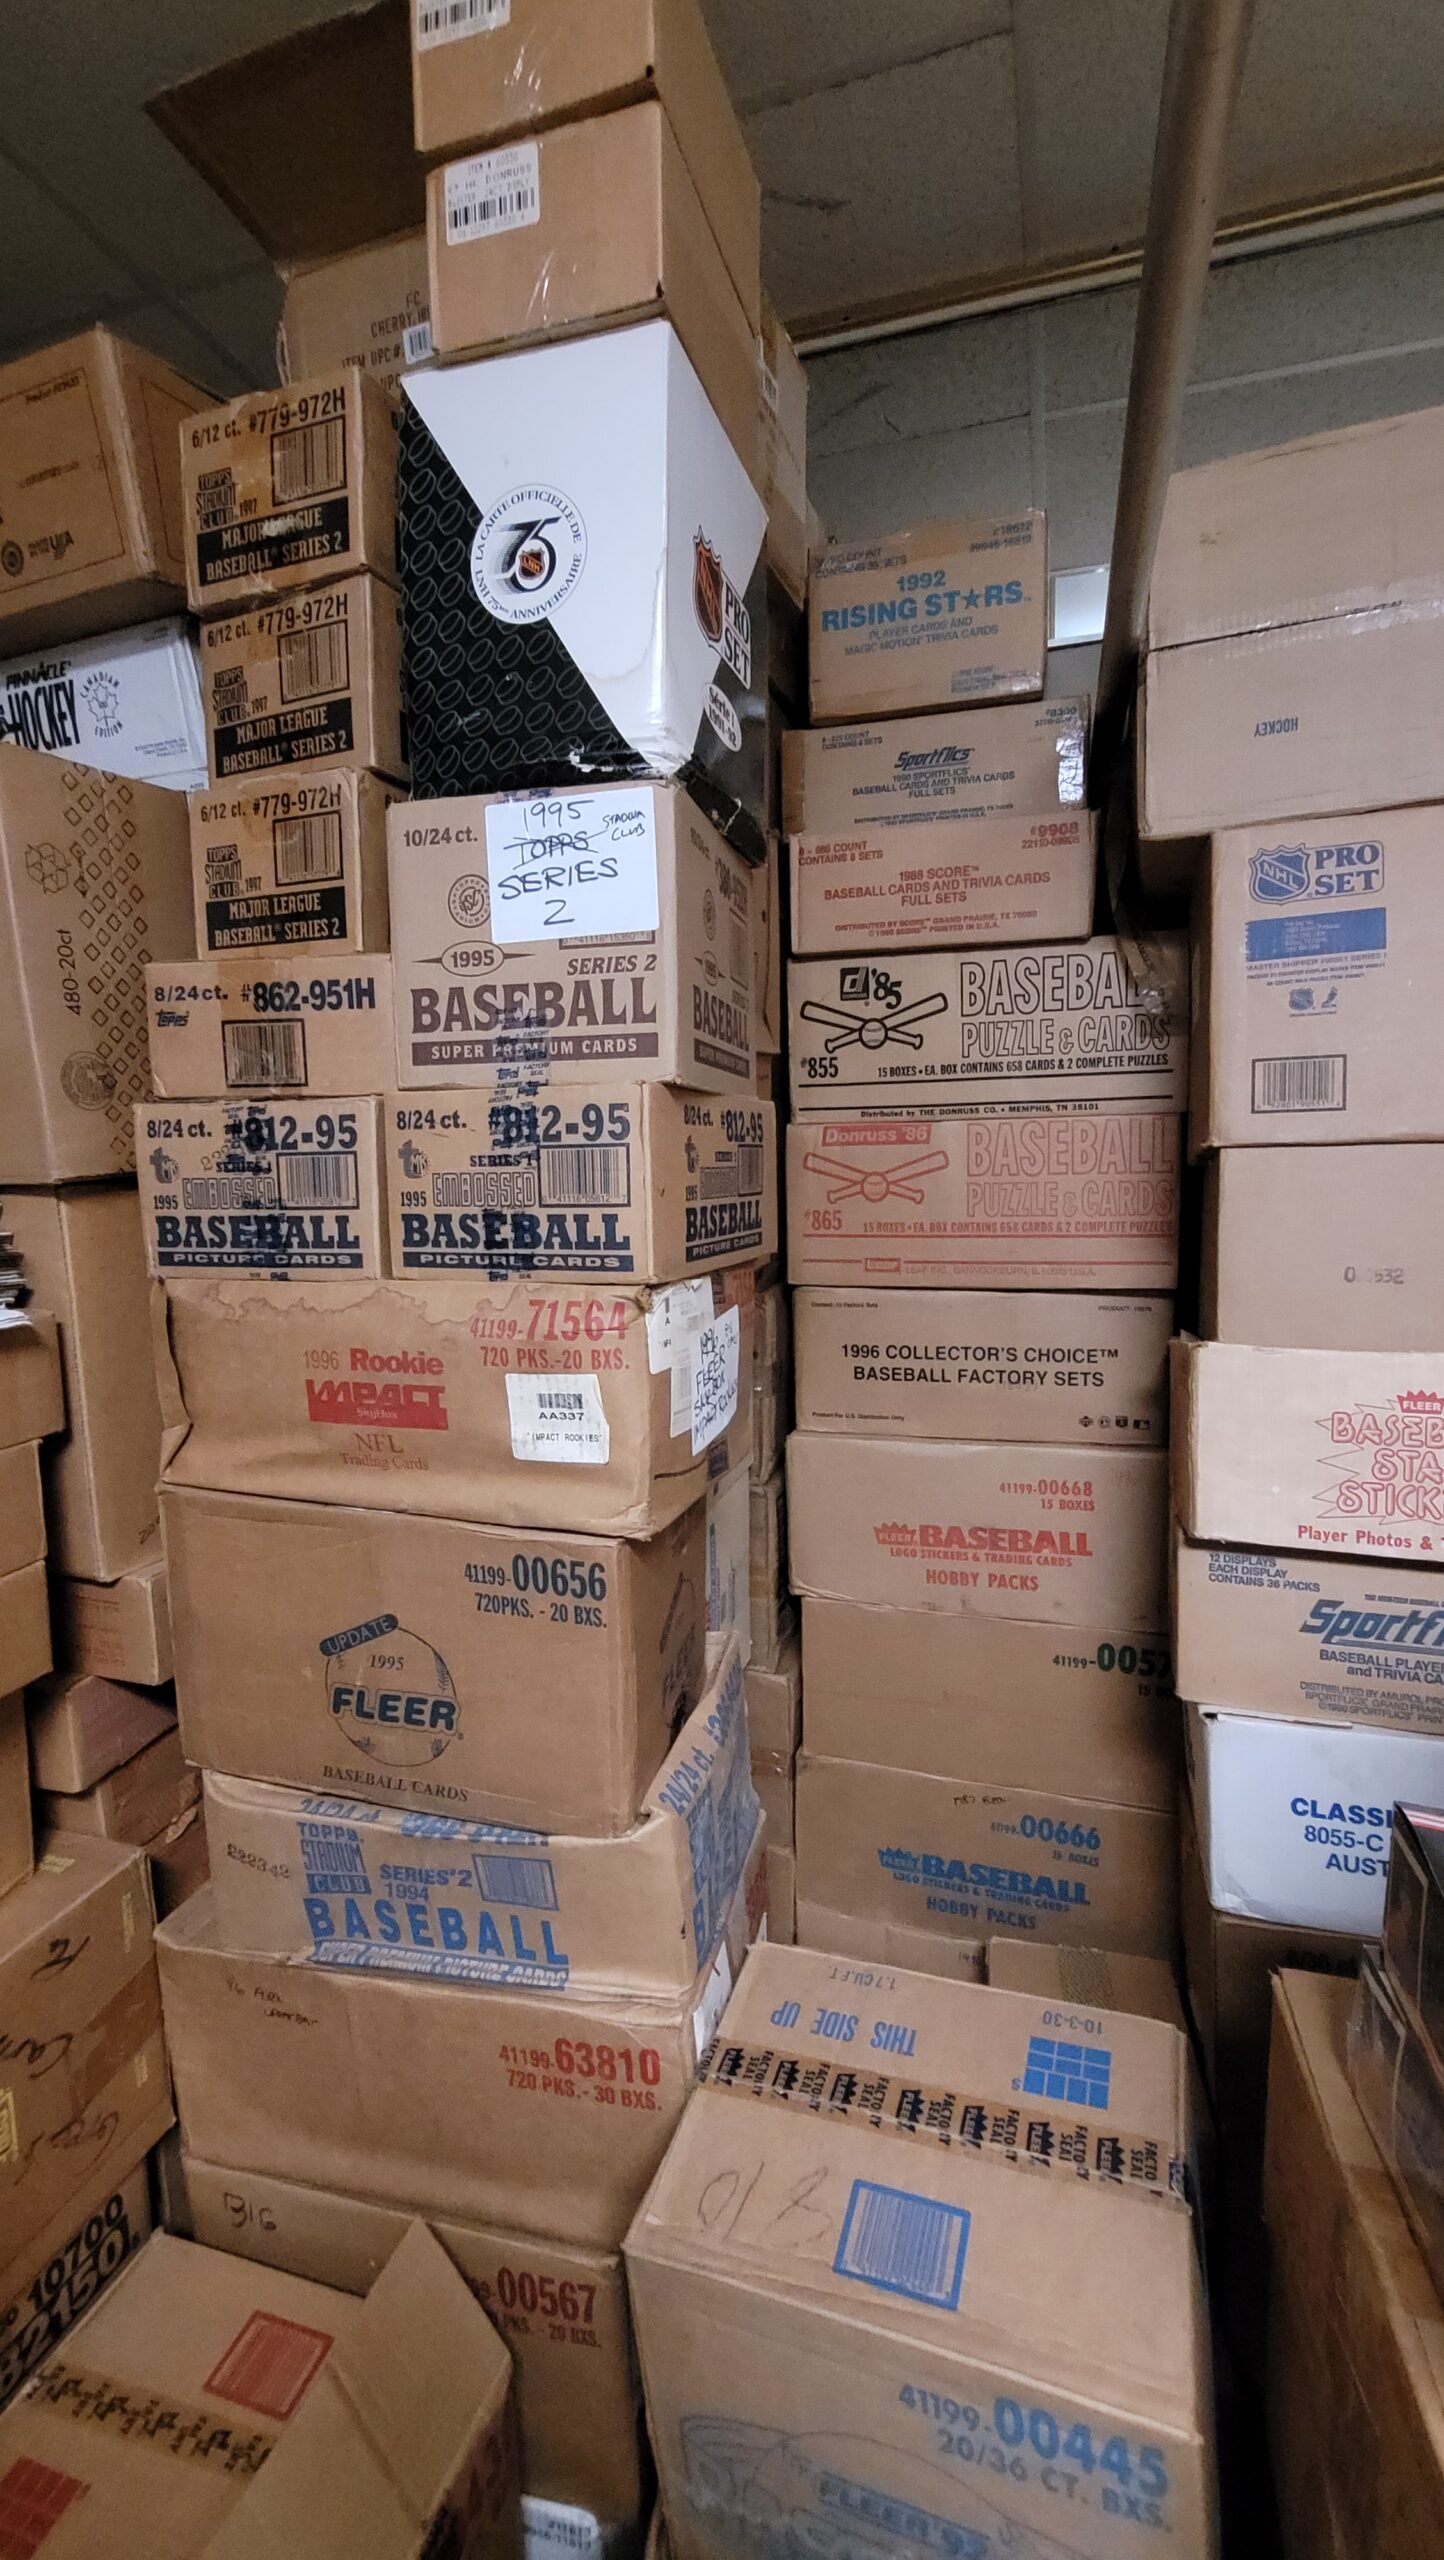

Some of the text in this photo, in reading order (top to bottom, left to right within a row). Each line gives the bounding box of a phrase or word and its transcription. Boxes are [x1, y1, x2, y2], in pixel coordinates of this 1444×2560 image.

[192, 387, 346, 448] 6/12 ct. #779-972H
[199, 468, 232, 490] TOPPS
[222, 521, 265, 548] MAJOR
[570, 522, 582, 543] DE
[206, 532, 342, 580] BASEBALL SERIES 2
[476, 544, 485, 560] LA
[896, 570, 946, 591] 1992
[208, 594, 348, 648] 6/12 ct. #779-972H
[725, 580, 750, 644] PRO
[821, 599, 918, 633] RISING
[724, 626, 750, 687] SET
[6, 661, 72, 691] PINNACLE
[80, 671, 120, 698] CANADIAN
[214, 667, 242, 686] TOPPS
[9, 679, 80, 750] HOCKEY
[237, 707, 328, 744] MAJOR LEAGUE
[1254, 717, 1298, 738] HOCKEY
[95, 721, 123, 737] EDITION
[223, 729, 348, 773] BASEBALL SERIES 2
[894, 746, 972, 770] Sportflics
[852, 771, 1015, 796] BASEBALL CARDS AND TRIVIA CARDS
[201, 784, 341, 823] 6/12 ct. #779-972H
[522, 799, 596, 831] 1995
[404, 827, 478, 847] 10/24 ct.
[207, 844, 238, 861] TOPPS
[1314, 844, 1380, 870] PRO
[498, 858, 618, 900] SERIES
[824, 872, 1050, 900] BASEBALL CARDS AND TRIVIA CARDS
[1261, 860, 1300, 890] NHL
[1315, 870, 1380, 896] SET
[230, 893, 321, 920] MAJOR LEAGUE
[900, 891, 967, 906] FULL SETS
[543, 899, 575, 926] 2
[214, 914, 339, 947] BASEBALL SERIES 2
[57, 928, 82, 1016] 480-20ct
[451, 950, 494, 968] 1995
[567, 954, 657, 976] SERIES 2
[410, 977, 657, 1034] BASEBALL
[693, 983, 750, 1051] BASEBALL
[432, 1038, 637, 1060] SUPER PREMIUM CARDS
[800, 1057, 839, 1080] #855
[878, 1053, 1169, 1078] 15 BOXES EA. BOX CONTAINS 658 CARDS & 2 COMPLETE PUZZLES
[861, 1109, 903, 1119] Distributed
[906, 1110, 915, 1119] by
[919, 1108, 936, 1117] THE
[939, 1106, 980, 1116] DONRUSS
[983, 1105, 998, 1114] CO.
[1008, 1104, 1053, 1114] MEMPHIS,
[1056, 1103, 1068, 1112] TN
[824, 1126, 928, 1144] Donruss '86
[967, 1119, 1175, 1178] BASEBALL
[154, 1195, 178, 1210] 1995
[182, 1177, 283, 1210] EMBOSSED
[400, 1190, 427, 1207] 1995
[432, 1171, 537, 1208] EMBOSSED
[156, 1214, 360, 1249] BASEBALL
[401, 1213, 630, 1251] BASEBALL
[685, 1200, 762, 1242] BASEBALL
[420, 1254, 620, 1268] PICTURE CARDS
[470, 1299, 629, 1343] 41199-71564
[303, 1348, 444, 1375] 1996 Rookie
[841, 1343, 880, 1359] 1996
[885, 1345, 1017, 1362] COLLECTOR'S
[853, 1366, 1105, 1387] BASEBALL FACTORY SETS
[539, 1411, 584, 1422] AA337
[1402, 1401, 1442, 1412] FLEER
[354, 1433, 403, 1453] NFL
[339, 1453, 429, 1470] Trading Cards
[1041, 1499, 1095, 1512] 15 BOXES
[918, 1524, 1093, 1557] BASEBALL
[1298, 1525, 1433, 1550] Player Photos &
[890, 1548, 917, 1559] LOGO
[920, 1549, 969, 1562] STICKERS
[984, 1552, 1033, 1566] TRADING
[1036, 1557, 1072, 1567] CARDS
[1209, 1553, 1277, 1567] 12 DISPLAYS
[464, 1554, 607, 1602] 41199-00656
[926, 1569, 1039, 1592] HOBBY PACKS
[1209, 1564, 1288, 1579] EACH DISPLAY
[1209, 1573, 1320, 1592] CONTAINS 36 PACKS
[328, 1616, 390, 1652] UPDATE
[370, 1654, 405, 1671] 1995
[1320, 1650, 1393, 1667] BASEBALL
[1347, 1665, 1421, 1682] and TRIVIA
[332, 1686, 457, 1732] FLEER
[323, 1765, 468, 1802] BASEBALL CARDS
[1304, 1825, 1384, 1852] 8055-C
[384, 1882, 430, 1901] 1994
[922, 1853, 1090, 1905] BASEBALL
[303, 1898, 569, 1965] BASEBALL
[768, 2001, 917, 2058] THIS SIDE UP
[507, 2068, 662, 2111] 720 30 BXS.
